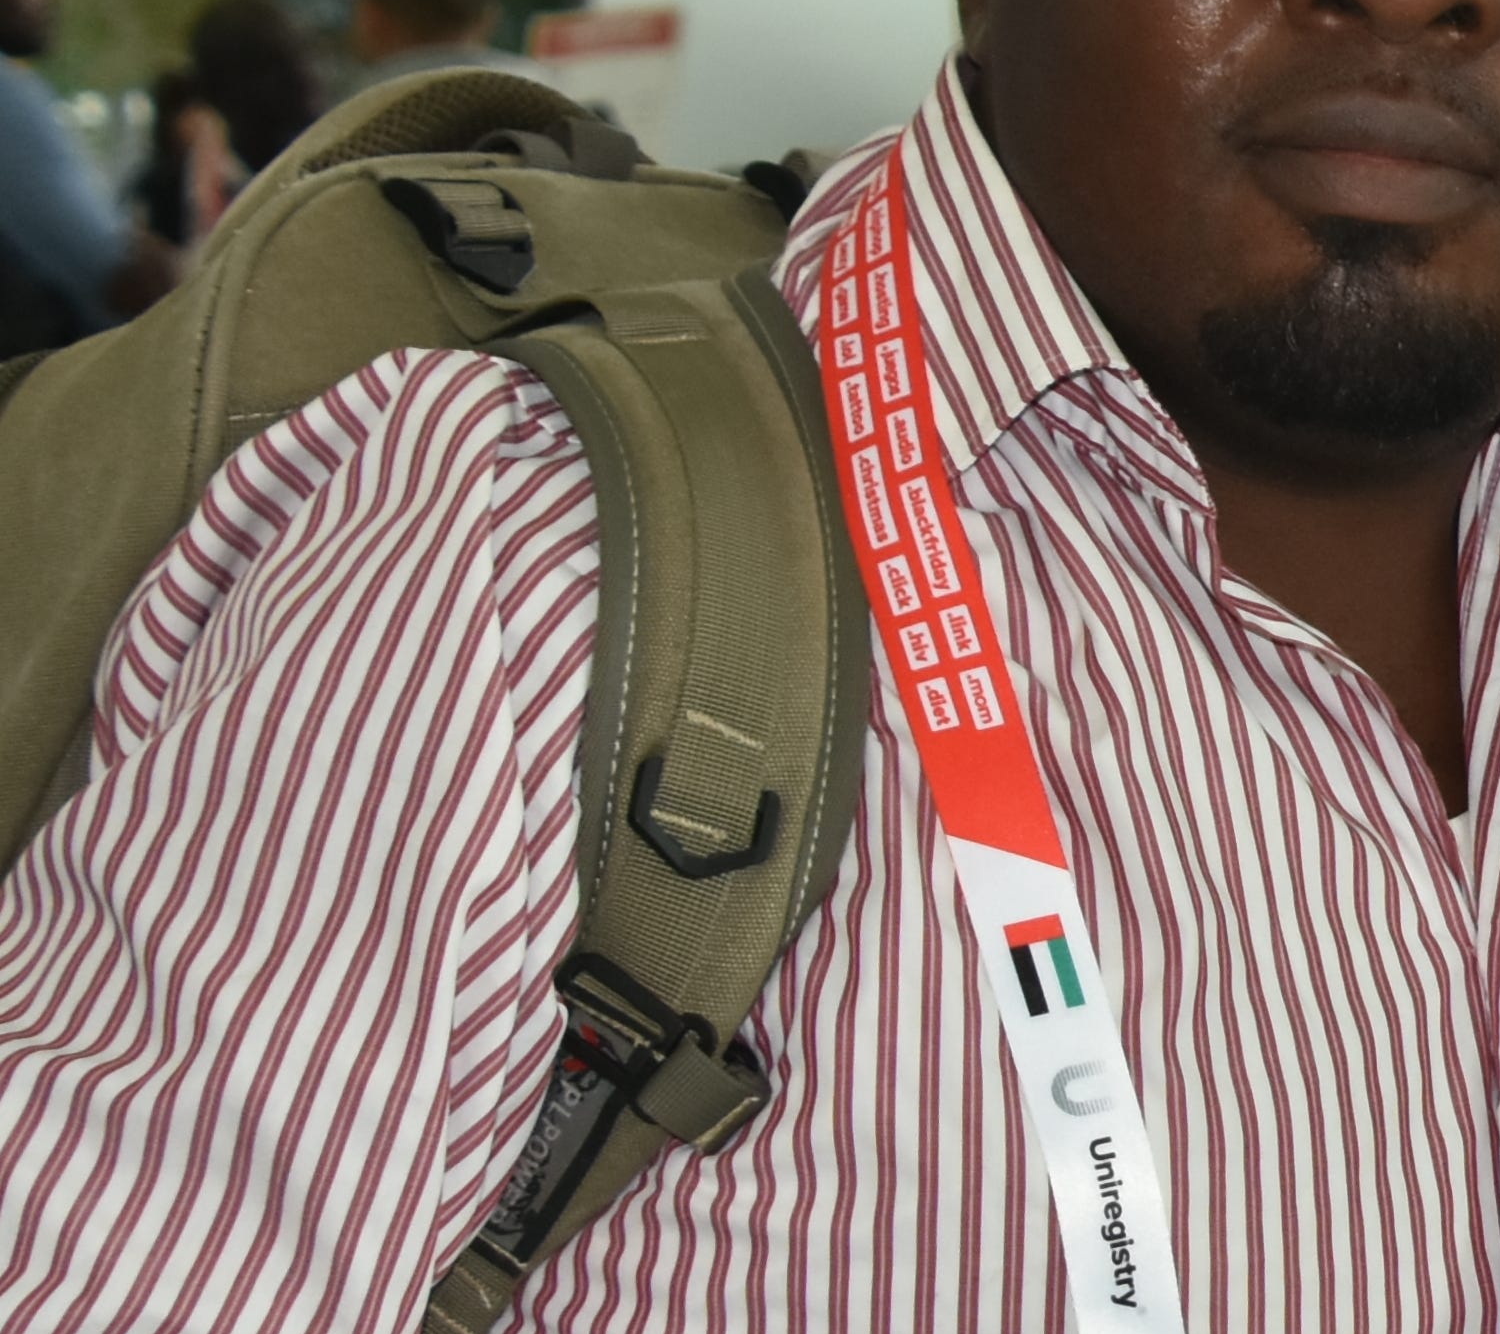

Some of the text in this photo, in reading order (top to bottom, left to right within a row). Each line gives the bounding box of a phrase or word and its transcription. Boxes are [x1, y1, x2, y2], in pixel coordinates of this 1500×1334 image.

[858, 455, 889, 543] .christmas
[906, 484, 951, 592] .blackfriday
[885, 563, 911, 610] .click
[907, 630, 929, 663] .hiv
[947, 611, 971, 652] .link
[925, 684, 951, 727] .diet
[967, 673, 994, 725] .mom
[1088, 1136, 1138, 1310] Uniregistry
